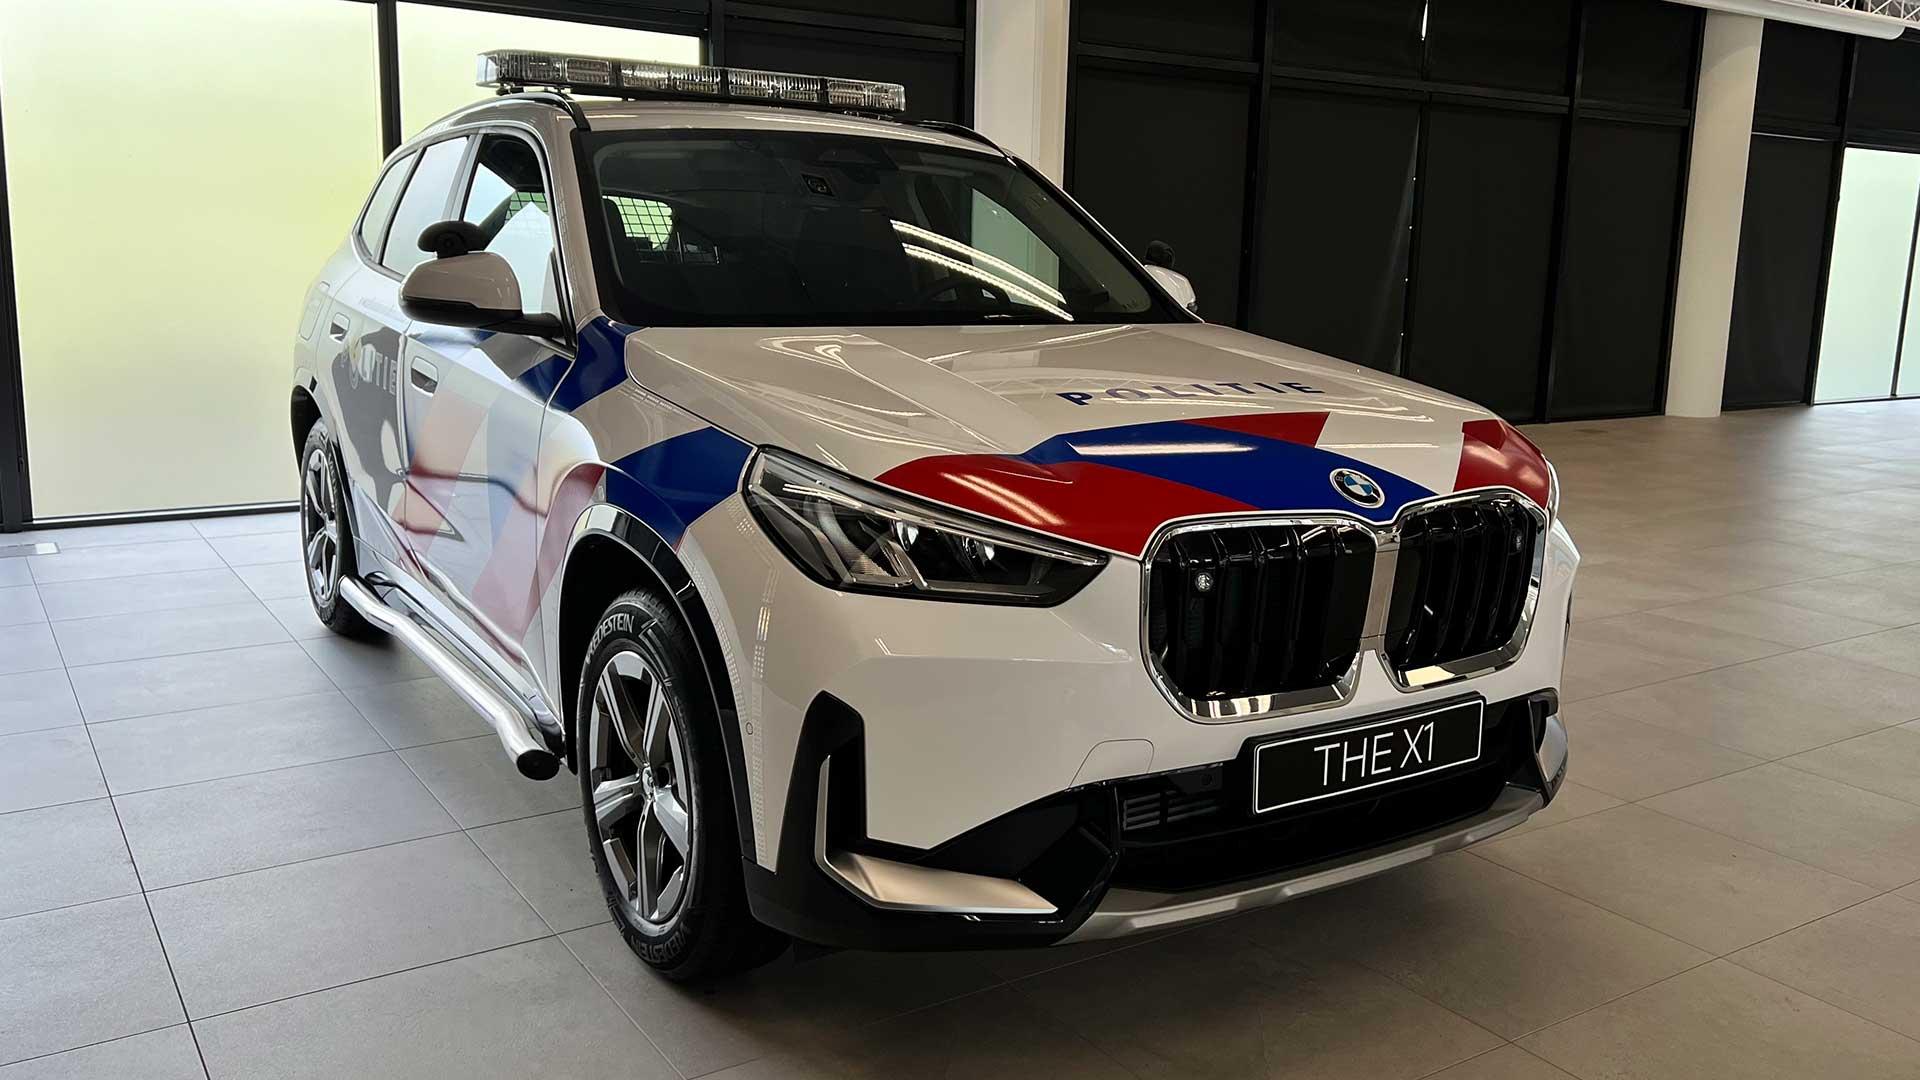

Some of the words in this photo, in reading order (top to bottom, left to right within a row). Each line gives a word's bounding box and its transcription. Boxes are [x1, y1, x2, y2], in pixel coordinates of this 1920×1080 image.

[1055, 381, 1325, 406] POLITIE
[1314, 731, 1394, 786] THE
[1400, 721, 1435, 769] X1
